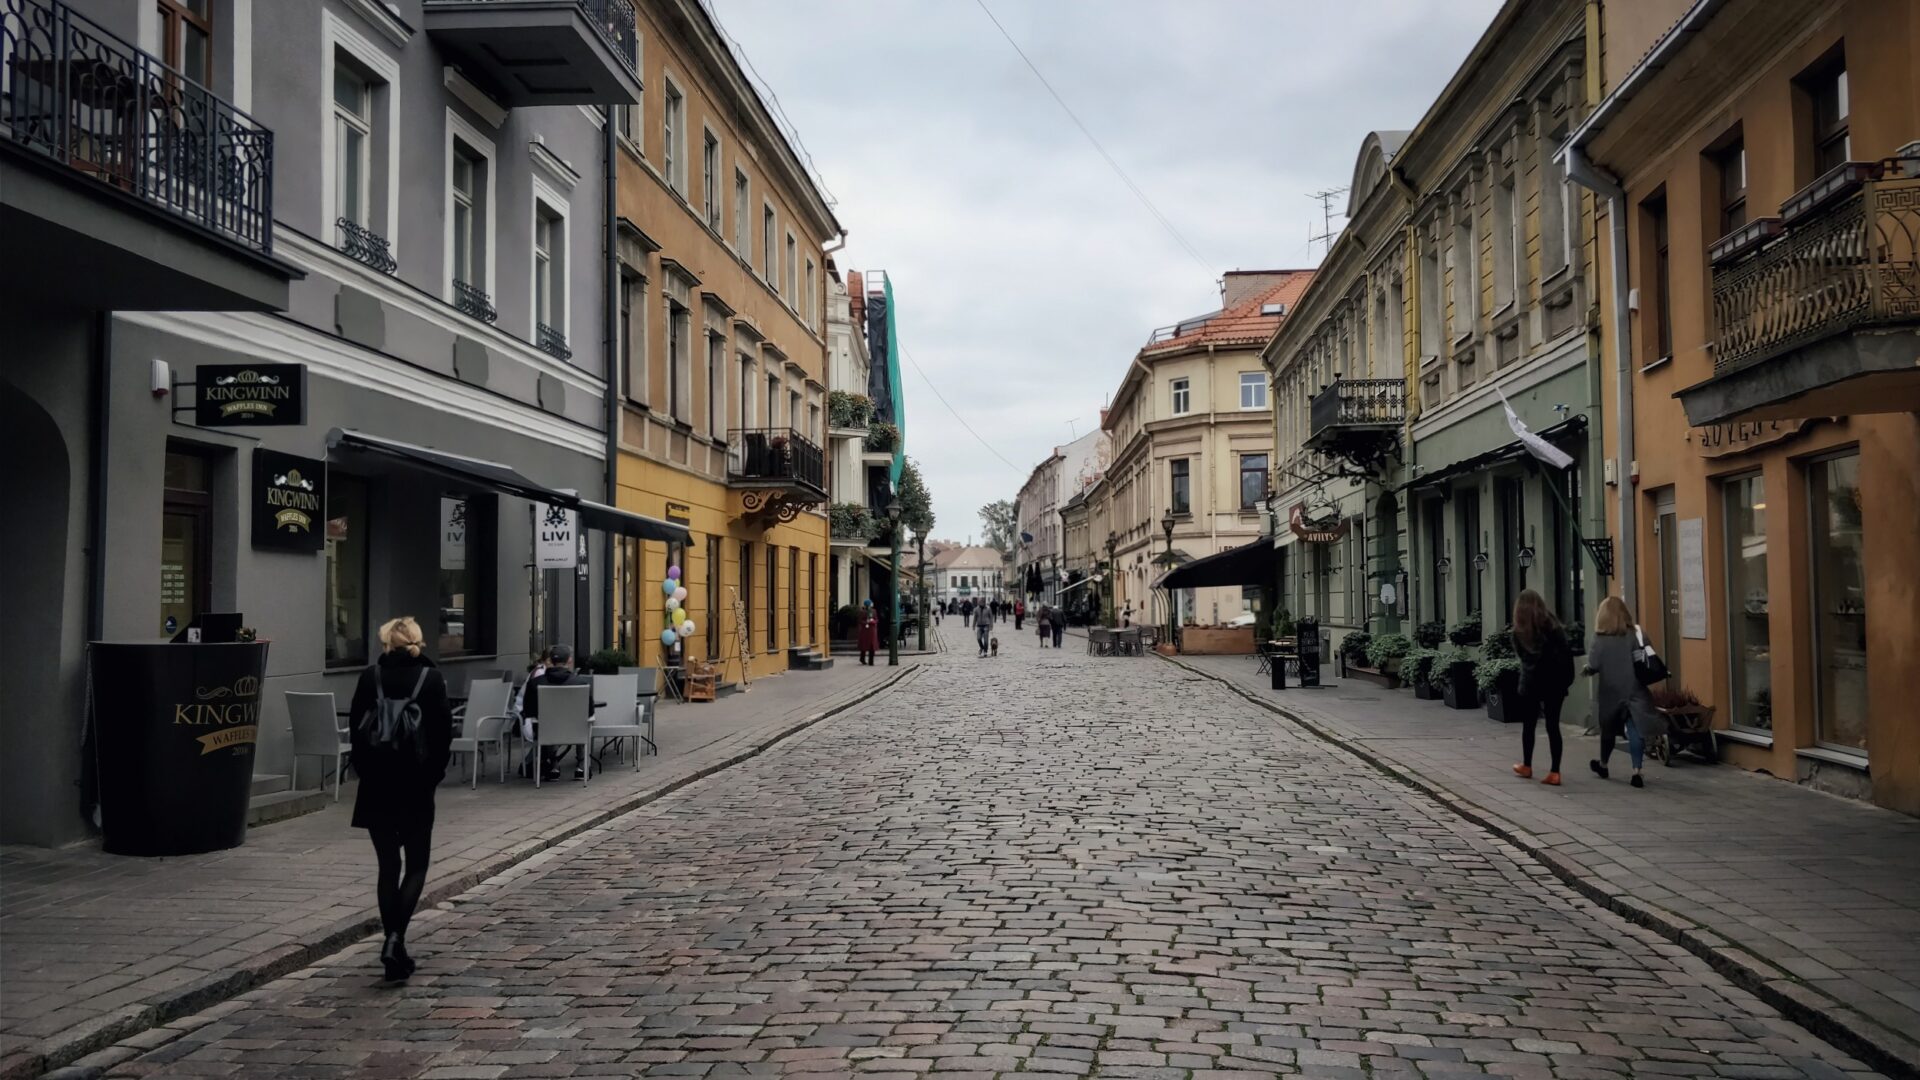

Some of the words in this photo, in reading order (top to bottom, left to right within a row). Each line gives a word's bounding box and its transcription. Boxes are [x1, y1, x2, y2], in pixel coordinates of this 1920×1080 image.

[206, 386, 289, 400] KINGWINN
[226, 402, 254, 412] WAFFLES
[267, 487, 320, 511] KINGWINN
[542, 531, 570, 541] LIVI
[1307, 533, 1334, 541] AVILYS
